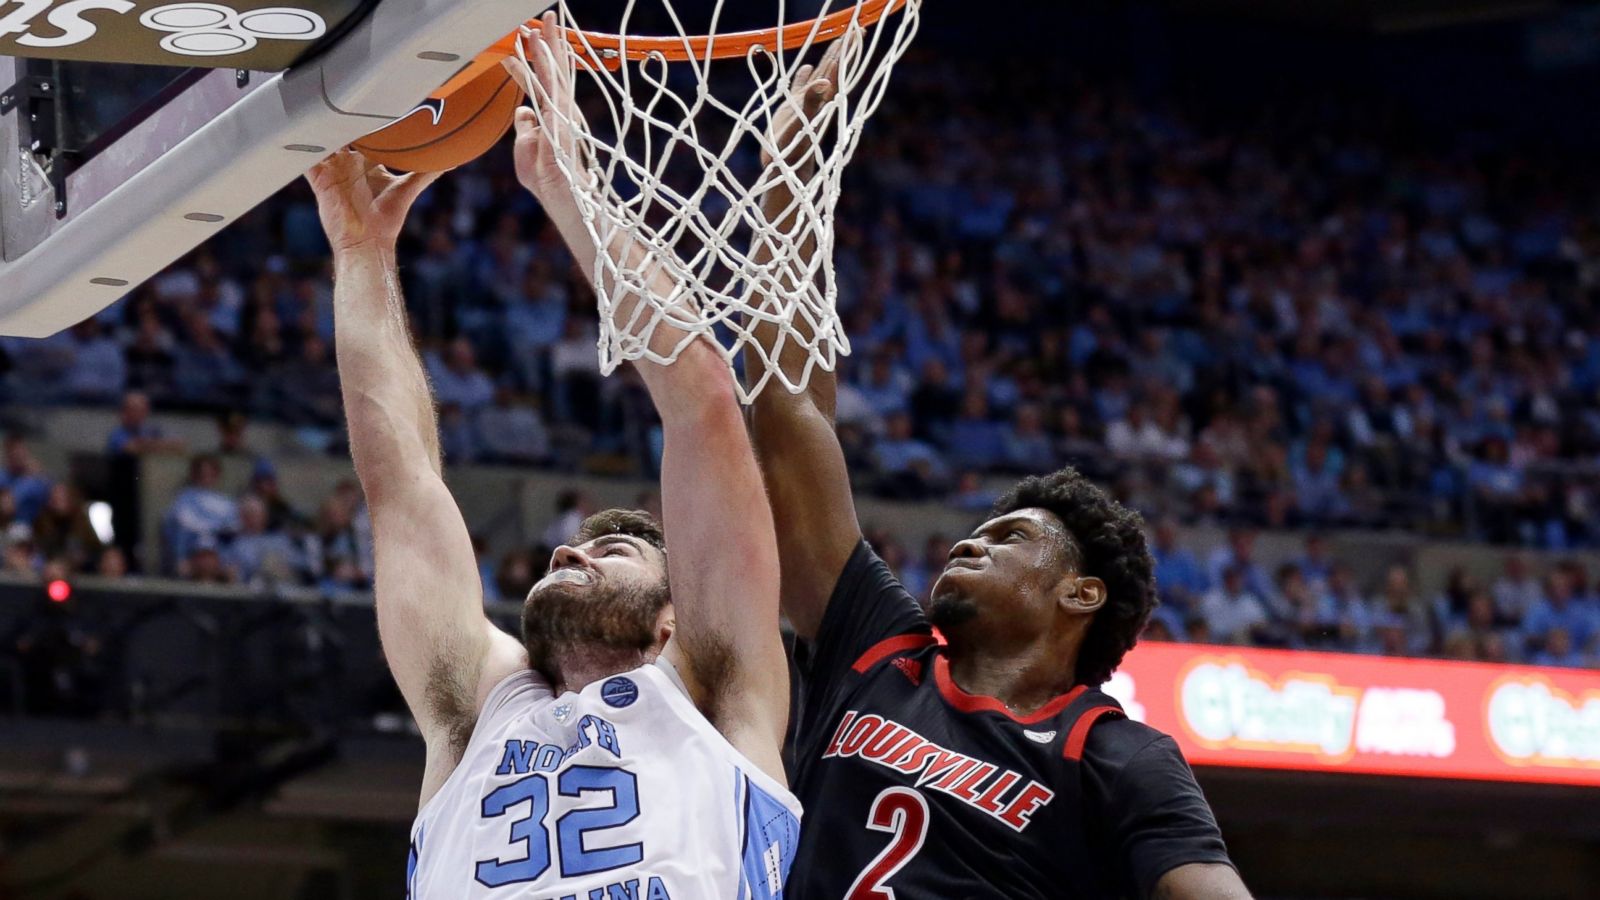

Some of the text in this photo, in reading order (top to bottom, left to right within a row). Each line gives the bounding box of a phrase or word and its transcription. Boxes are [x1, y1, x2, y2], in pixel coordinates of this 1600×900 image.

[474, 764, 644, 888] 32
[822, 710, 1056, 833] LOUISVILLE
[842, 786, 930, 900] 2
